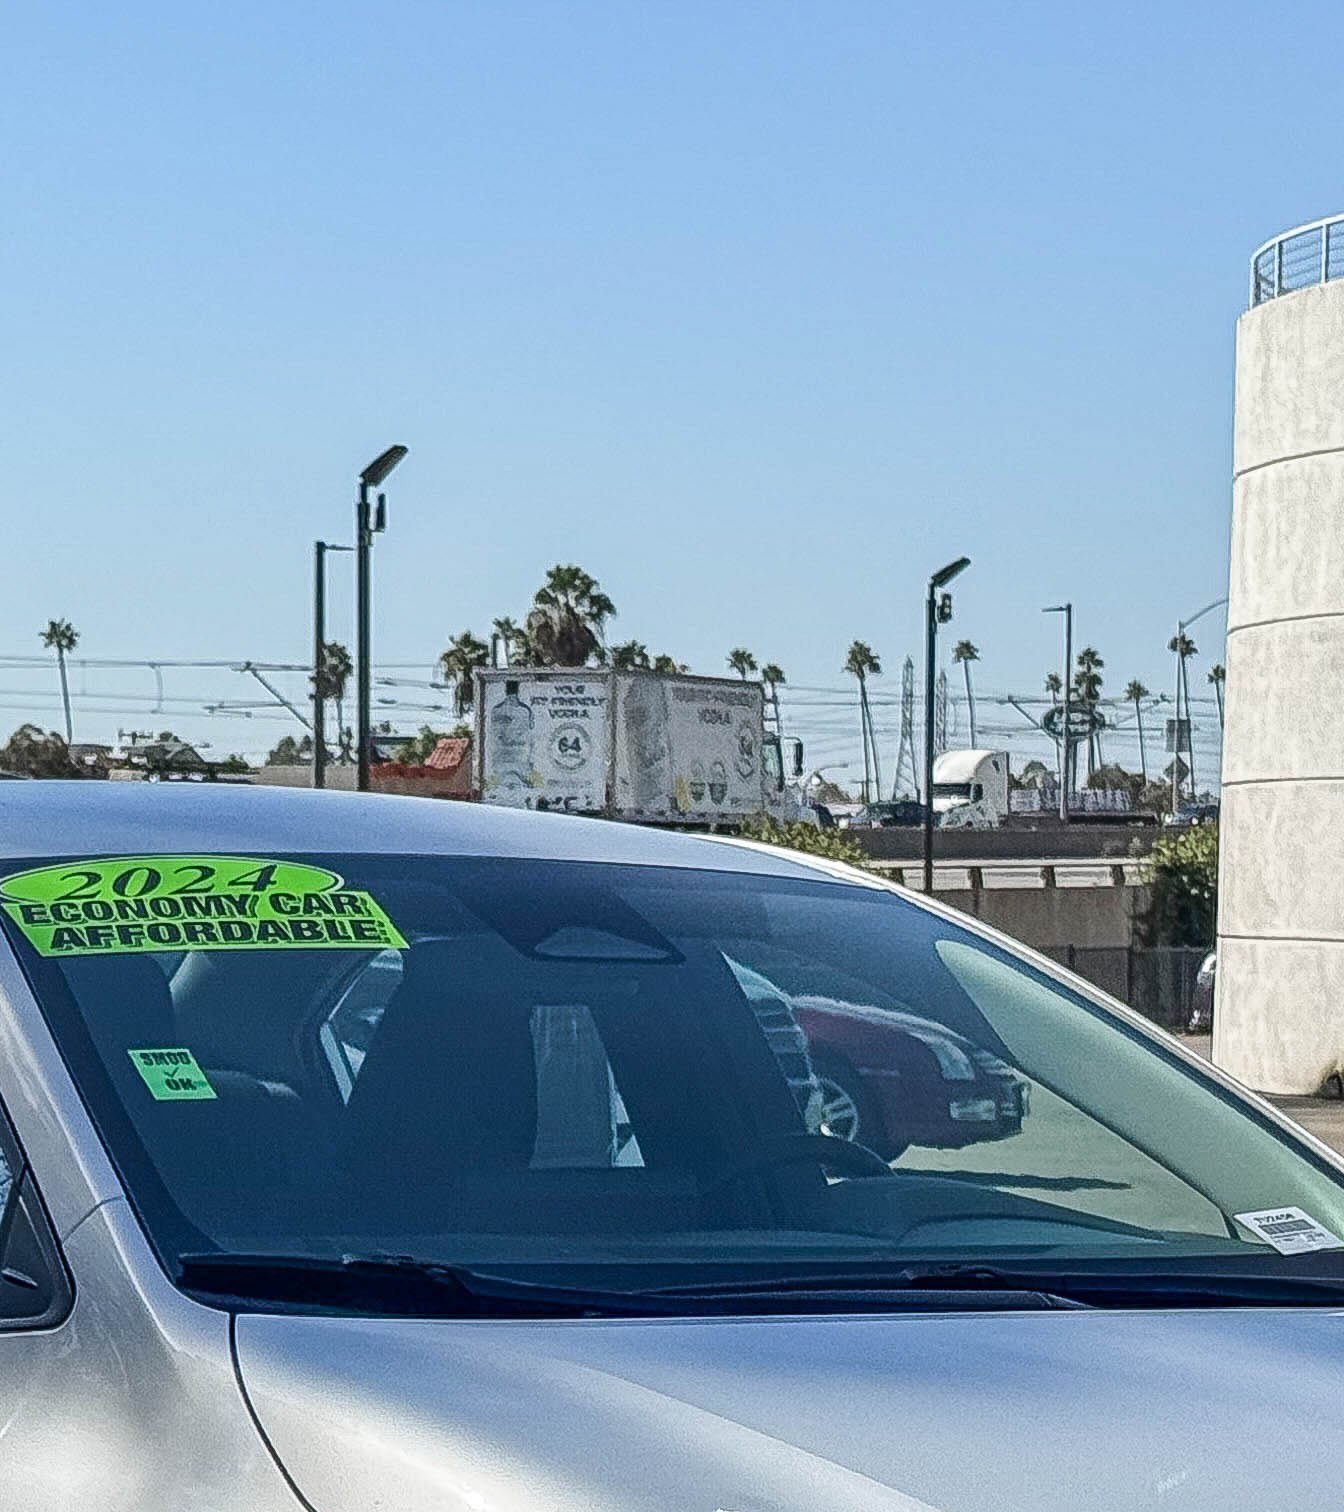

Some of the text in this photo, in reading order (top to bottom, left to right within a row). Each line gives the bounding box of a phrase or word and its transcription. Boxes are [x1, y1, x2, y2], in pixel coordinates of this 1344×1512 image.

[558, 736, 582, 753] 64
[58, 864, 278, 900] 2024
[22, 892, 367, 925] ECONOMY CAR
[165, 1078, 197, 1091] OK
